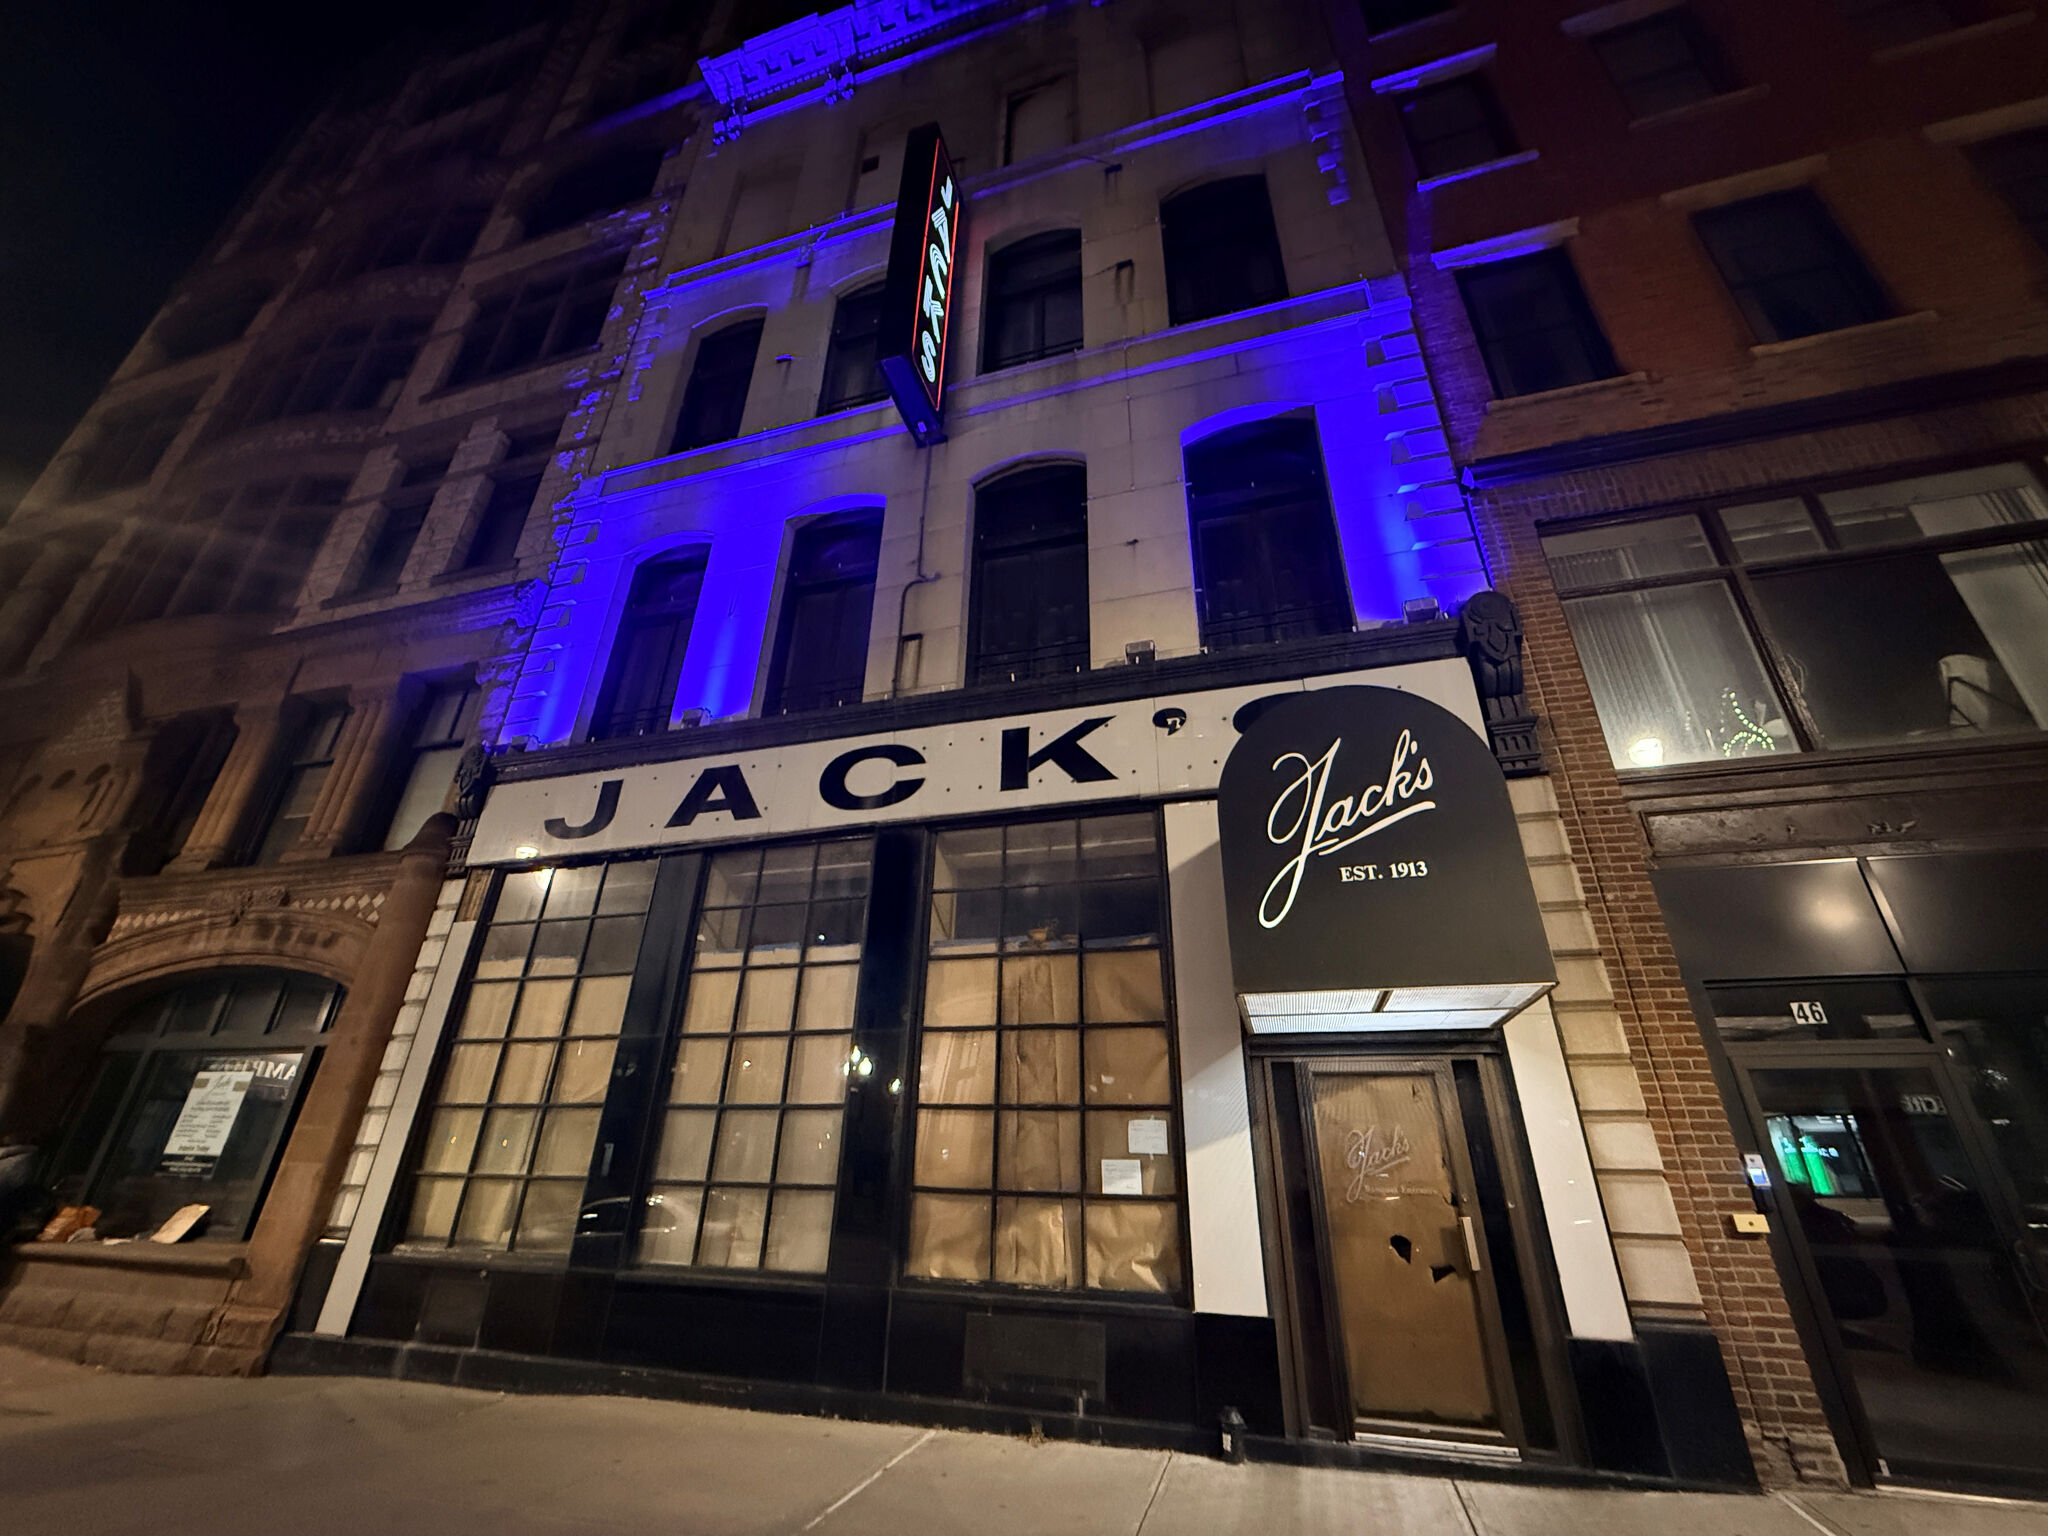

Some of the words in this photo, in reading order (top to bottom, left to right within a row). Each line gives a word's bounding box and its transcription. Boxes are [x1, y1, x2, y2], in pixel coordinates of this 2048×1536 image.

[544, 691, 1310, 839] JACK'
[1259, 729, 1434, 928] Jack's
[1340, 864, 1383, 882] EST.
[1389, 861, 1428, 879] 1913
[1797, 1002, 1824, 1022] 46
